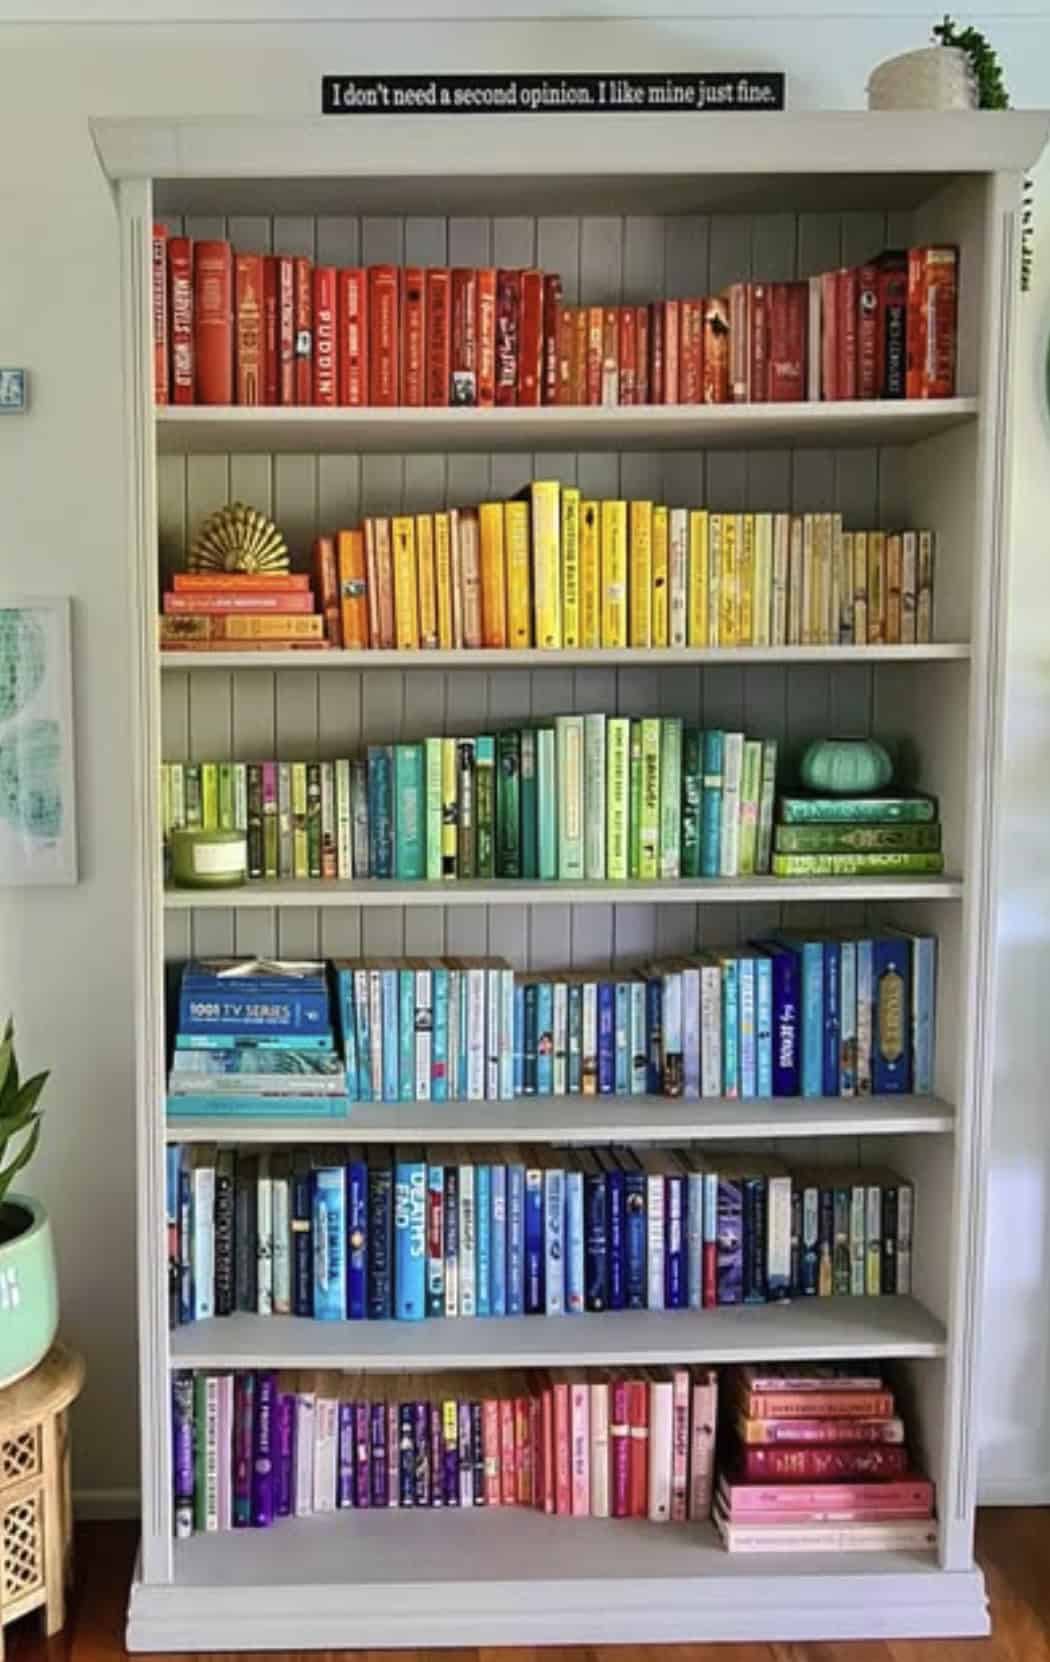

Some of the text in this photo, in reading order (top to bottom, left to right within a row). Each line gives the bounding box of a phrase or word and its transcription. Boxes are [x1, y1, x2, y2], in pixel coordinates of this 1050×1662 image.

[333, 79, 776, 108] I don't need a second opinion. I like mine just fine.
